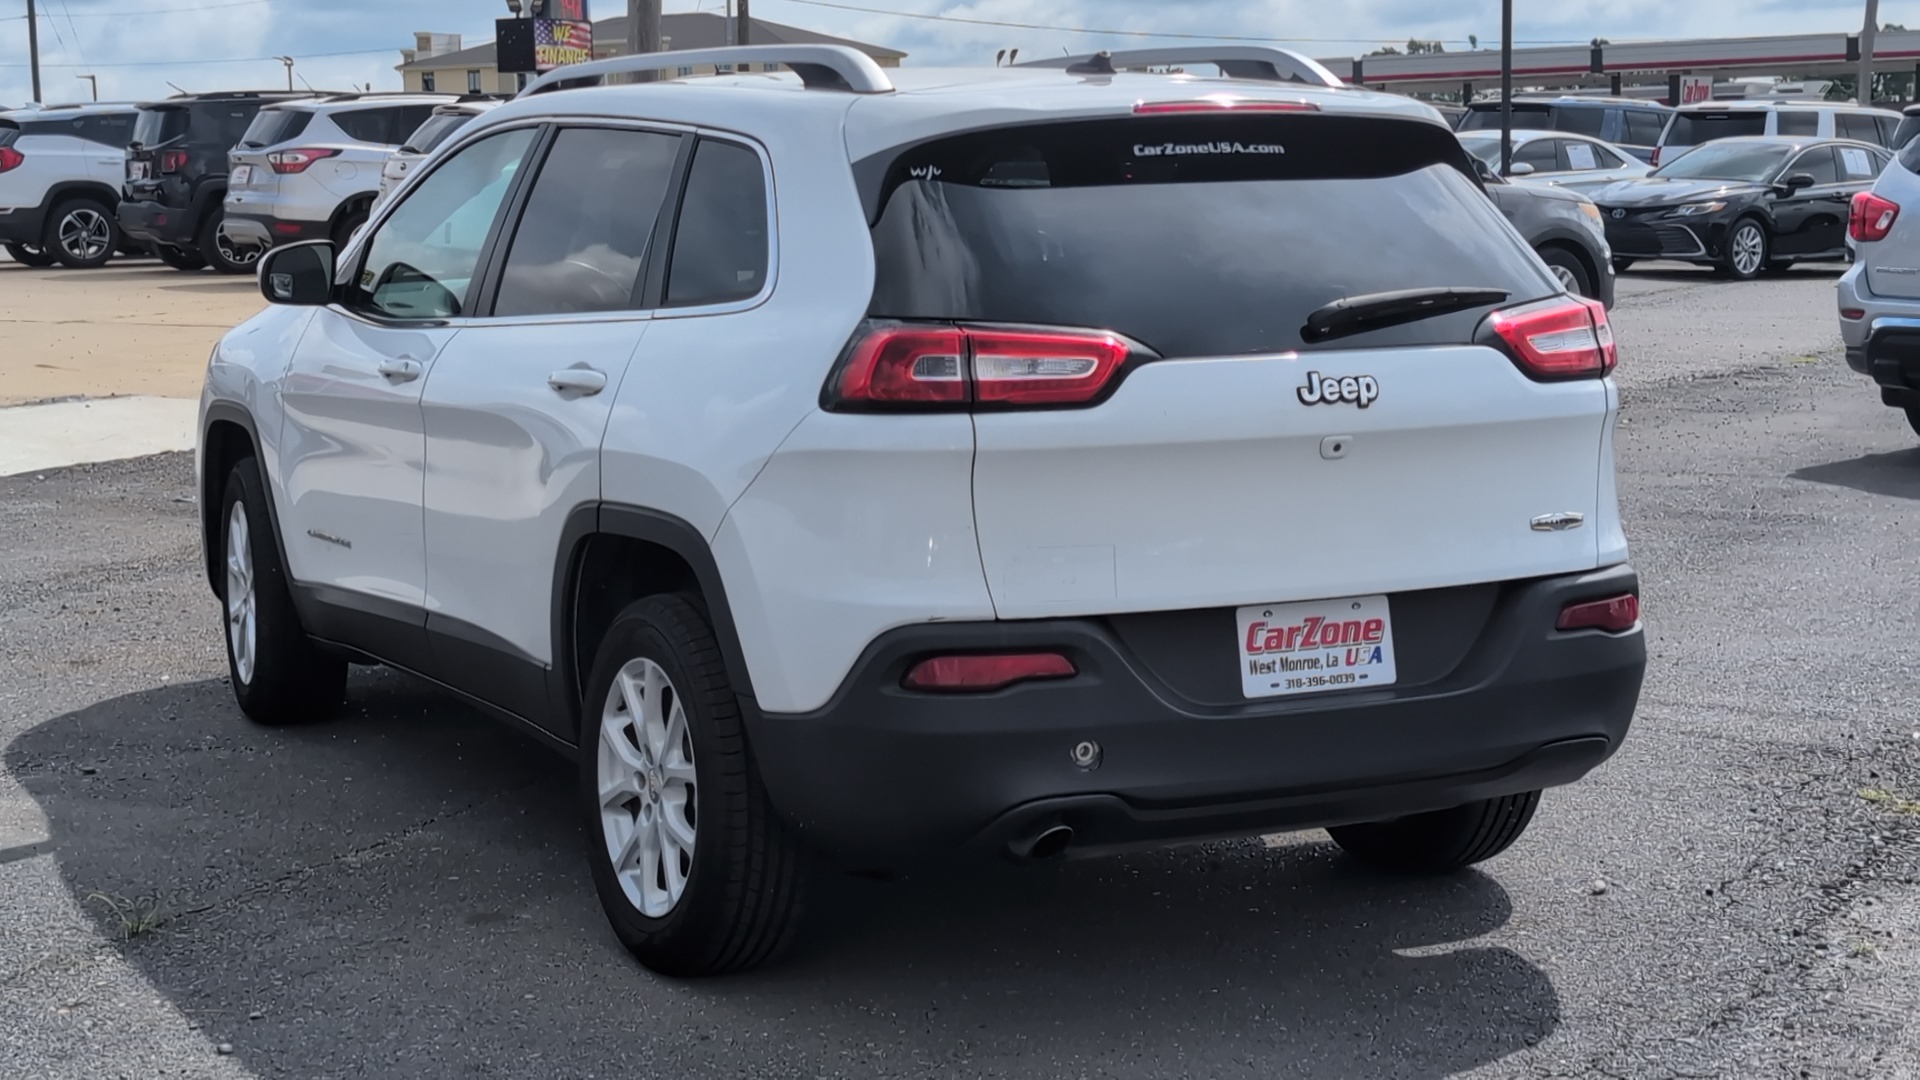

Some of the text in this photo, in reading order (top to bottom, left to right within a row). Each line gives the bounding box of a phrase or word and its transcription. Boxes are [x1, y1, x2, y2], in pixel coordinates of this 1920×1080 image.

[553, 24, 571, 41] WE
[538, 46, 589, 64] FINANCE
[1133, 142, 1285, 157] CarZoneUSA.com
[1296, 371, 1379, 409] Jeep
[1245, 616, 1386, 655] CarZone
[1249, 653, 1339, 676] West Monroe, La
[1345, 645, 1383, 667] USA
[1285, 673, 1356, 690] 318-396-0039
